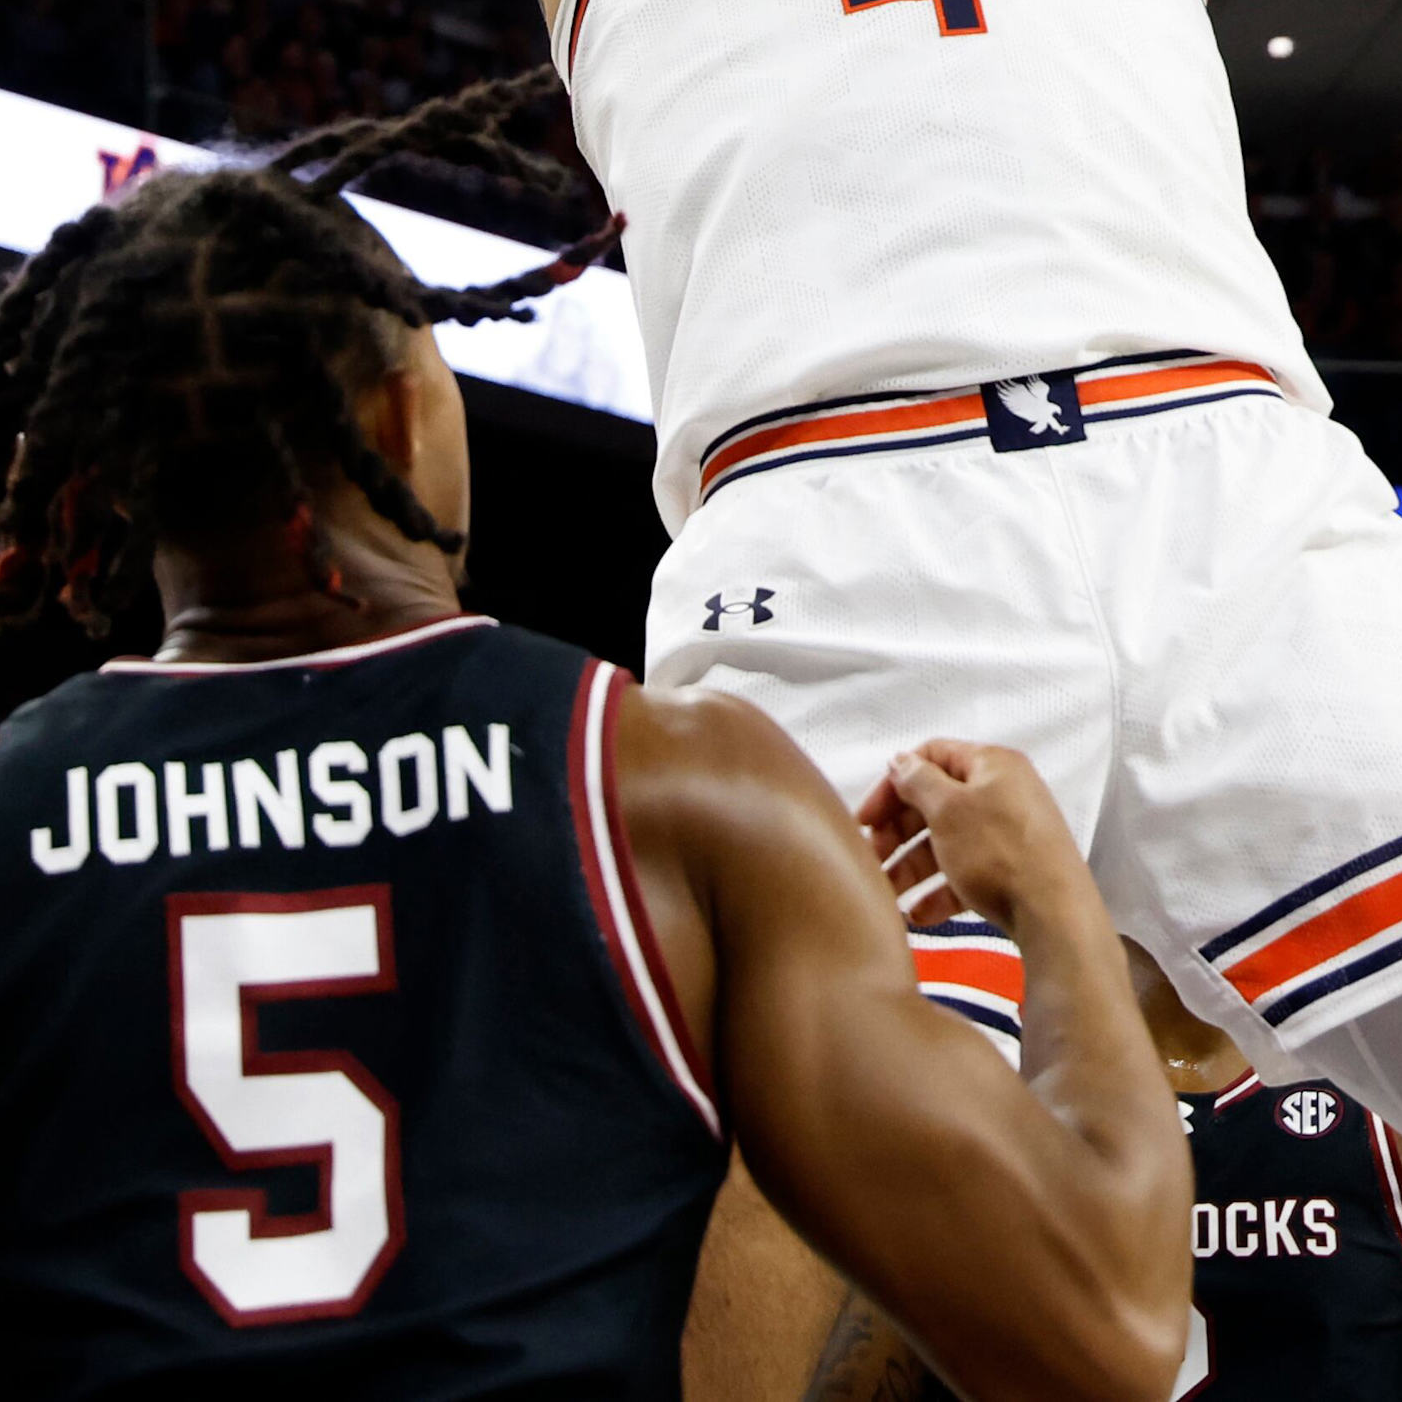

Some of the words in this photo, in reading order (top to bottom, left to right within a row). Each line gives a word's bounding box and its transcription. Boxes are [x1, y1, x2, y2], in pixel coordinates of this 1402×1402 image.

[31, 723, 513, 875] JOHNSON
[165, 883, 406, 1328] 5
[1282, 1091, 1337, 1136] SEC
[1190, 1198, 1338, 1259] OCKS
